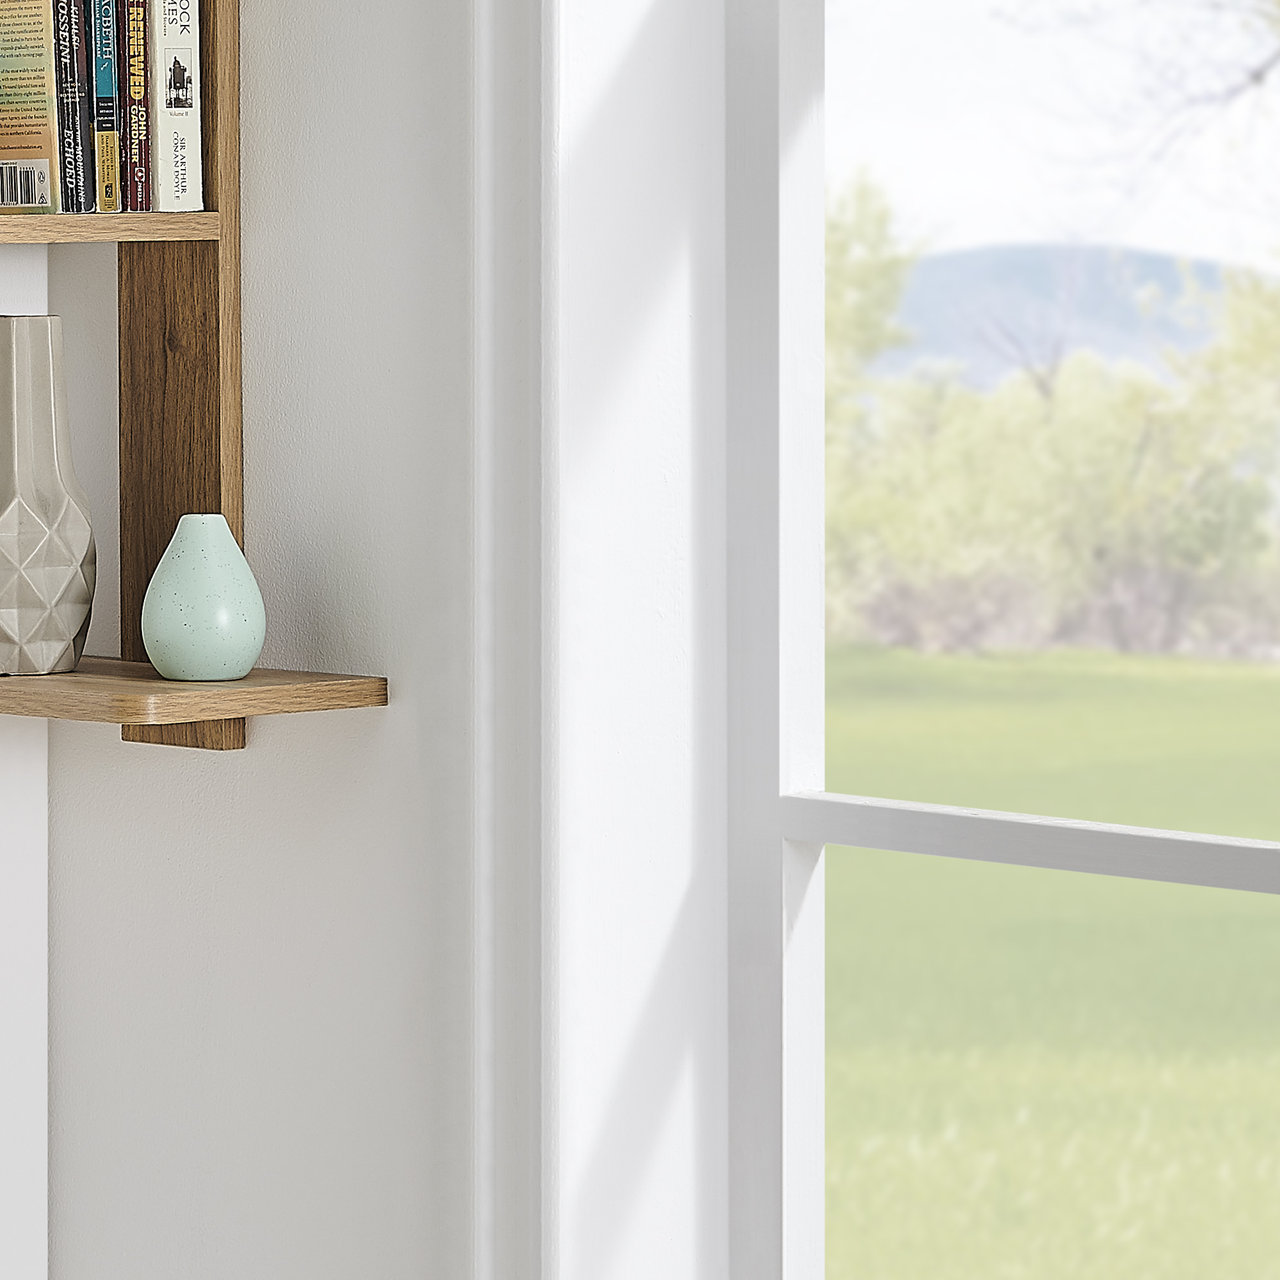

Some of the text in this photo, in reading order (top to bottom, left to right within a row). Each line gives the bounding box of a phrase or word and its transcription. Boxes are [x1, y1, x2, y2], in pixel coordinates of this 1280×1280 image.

[129, 7, 145, 100] RENEWED
[130, 105, 139, 163] GARDNER
[138, 105, 147, 140] JOHN
[63, 129, 76, 188] ECHOED
[75, 145, 85, 203] MOUNTAINS
[172, 131, 181, 201] CONAN DOYLE
[179, 154, 187, 195] ARTHUR
